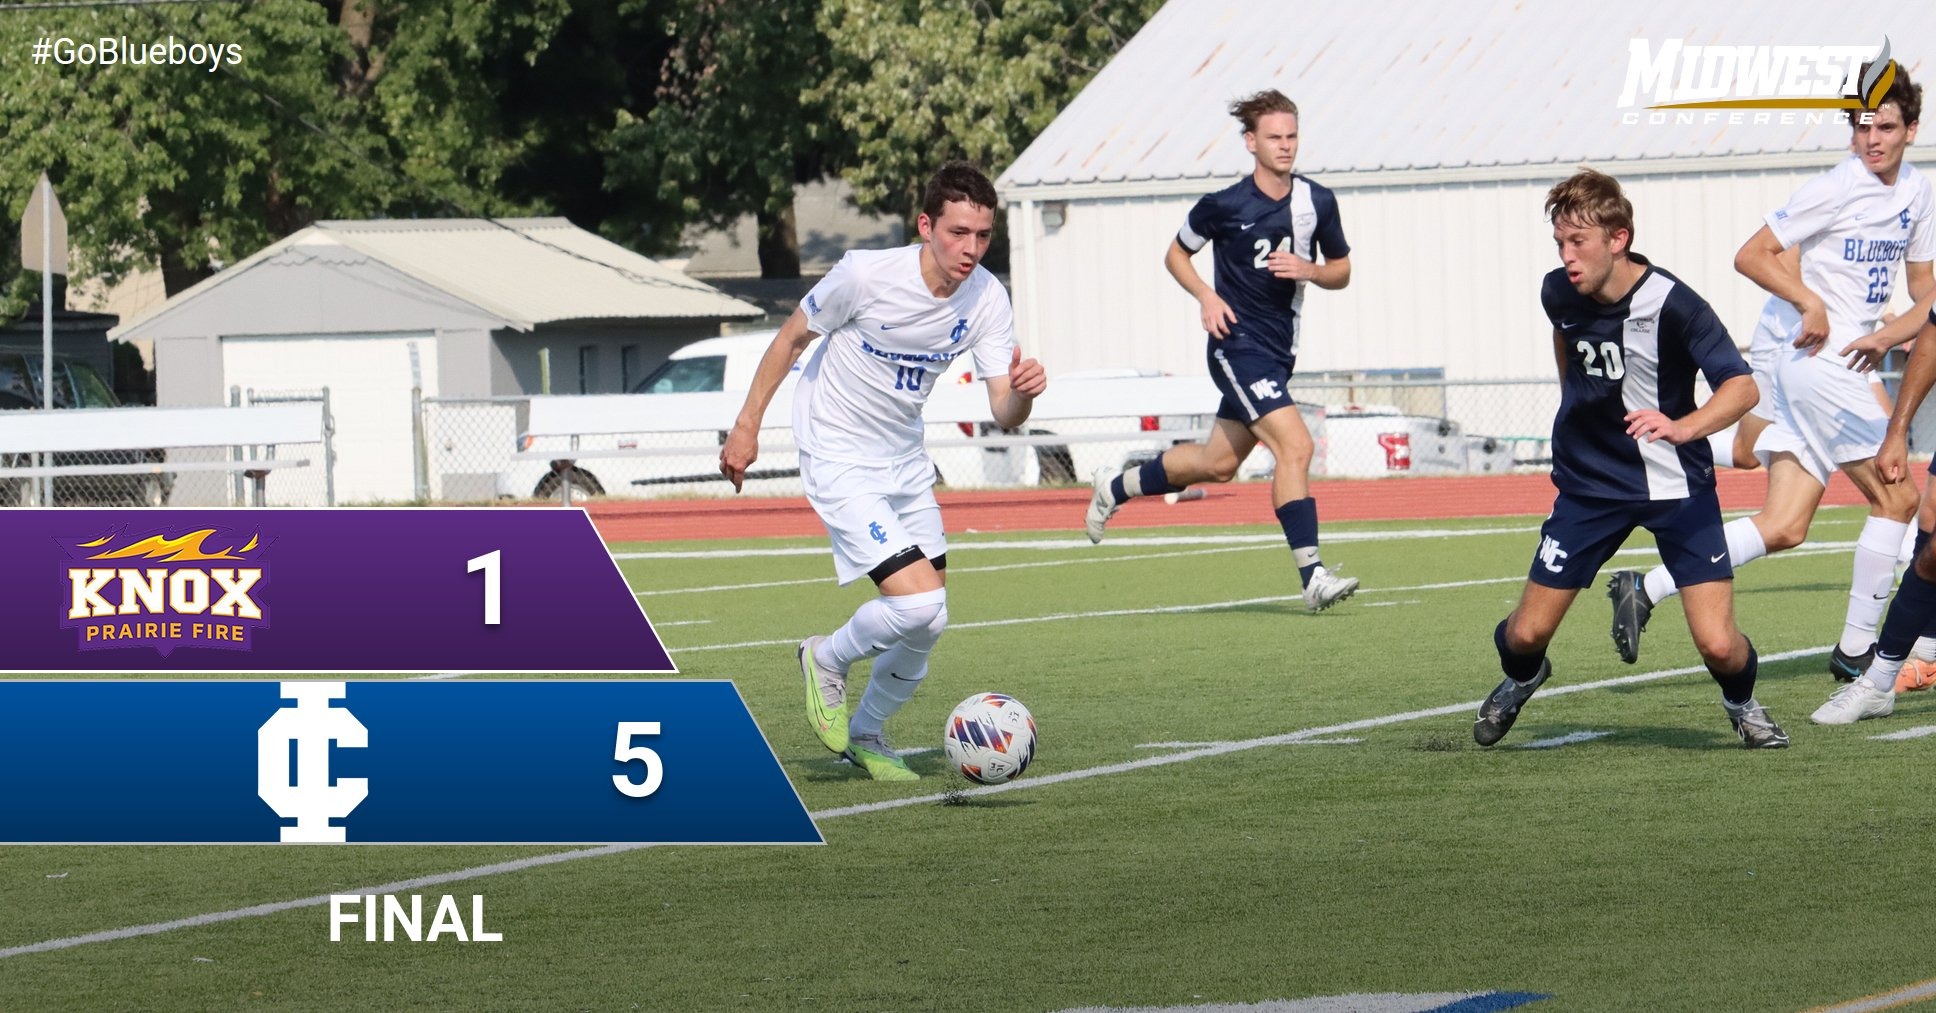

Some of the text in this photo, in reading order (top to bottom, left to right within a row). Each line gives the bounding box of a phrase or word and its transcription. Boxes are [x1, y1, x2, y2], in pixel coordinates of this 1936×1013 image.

[1843, 238, 1909, 262] BLUEBOY
[1866, 266, 1889, 303] 22
[1577, 340, 1626, 381] 20
[895, 366, 927, 391] 10
[1250, 378, 1283, 401] WC
[1539, 534, 1568, 573] WC
